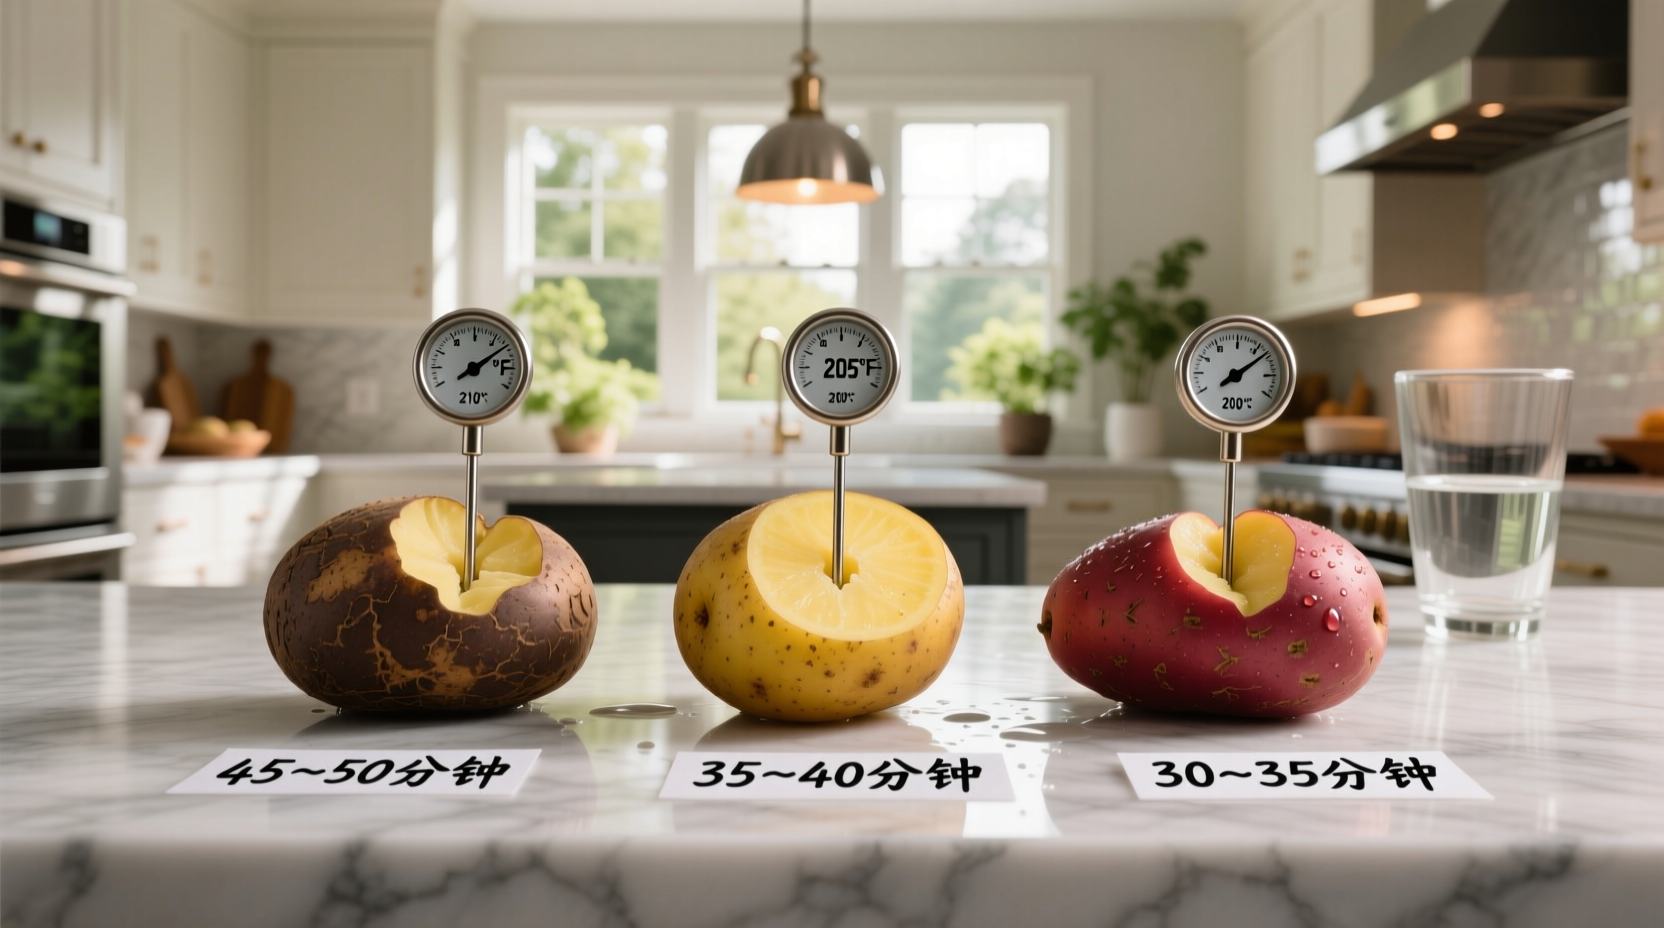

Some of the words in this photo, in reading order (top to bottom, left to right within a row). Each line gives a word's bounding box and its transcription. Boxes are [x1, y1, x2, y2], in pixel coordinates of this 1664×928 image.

[823, 358, 880, 379] 205°F
[216, 755, 511, 789] 45~50分钟
[692, 758, 983, 793] 35~40分钟
[1151, 757, 1437, 791] 30~35分钟
